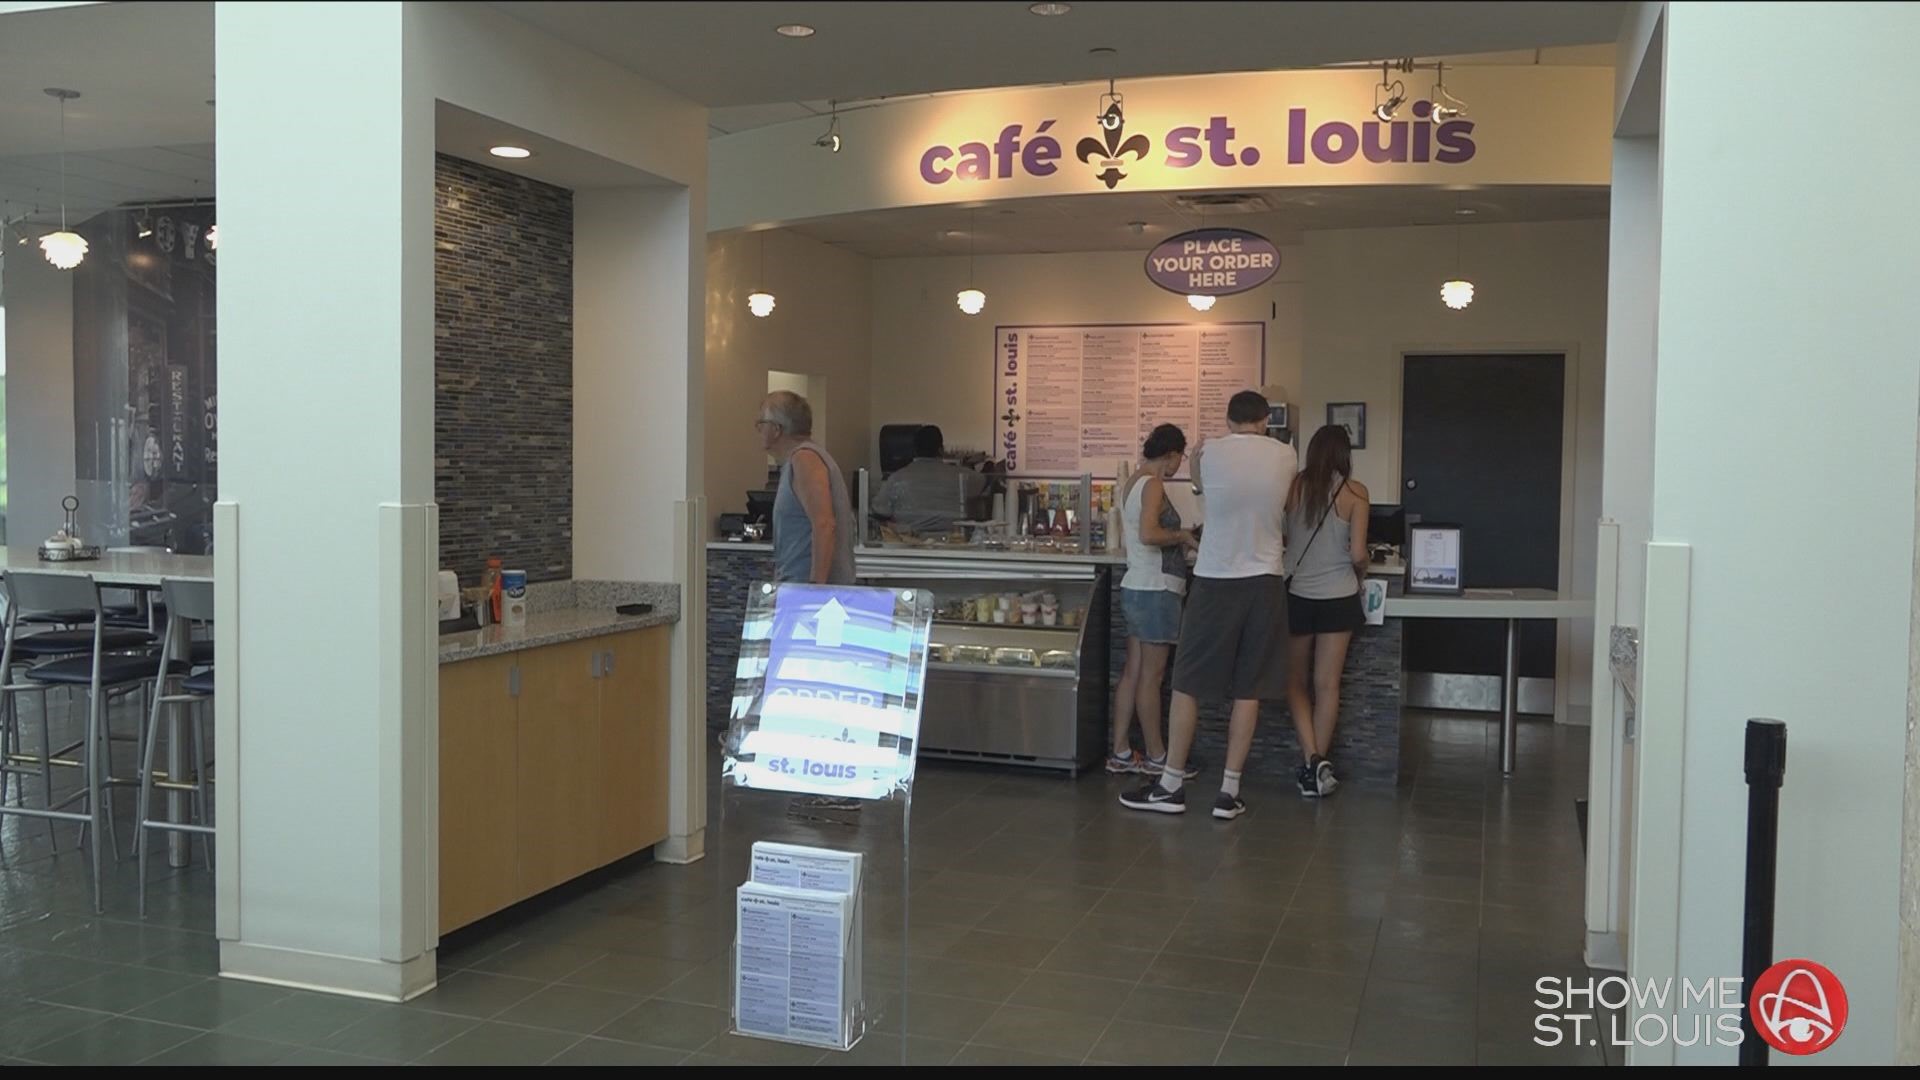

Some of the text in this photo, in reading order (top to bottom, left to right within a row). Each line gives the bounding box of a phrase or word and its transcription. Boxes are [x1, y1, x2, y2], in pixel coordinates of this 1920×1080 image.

[920, 99, 1476, 185] café st. louis
[1183, 238, 1242, 255] PLACE
[1152, 253, 1273, 273] YOUR ORDER
[1189, 271, 1237, 287] HERE
[1003, 332, 1019, 471] café st. louis
[768, 757, 857, 779] st. louis
